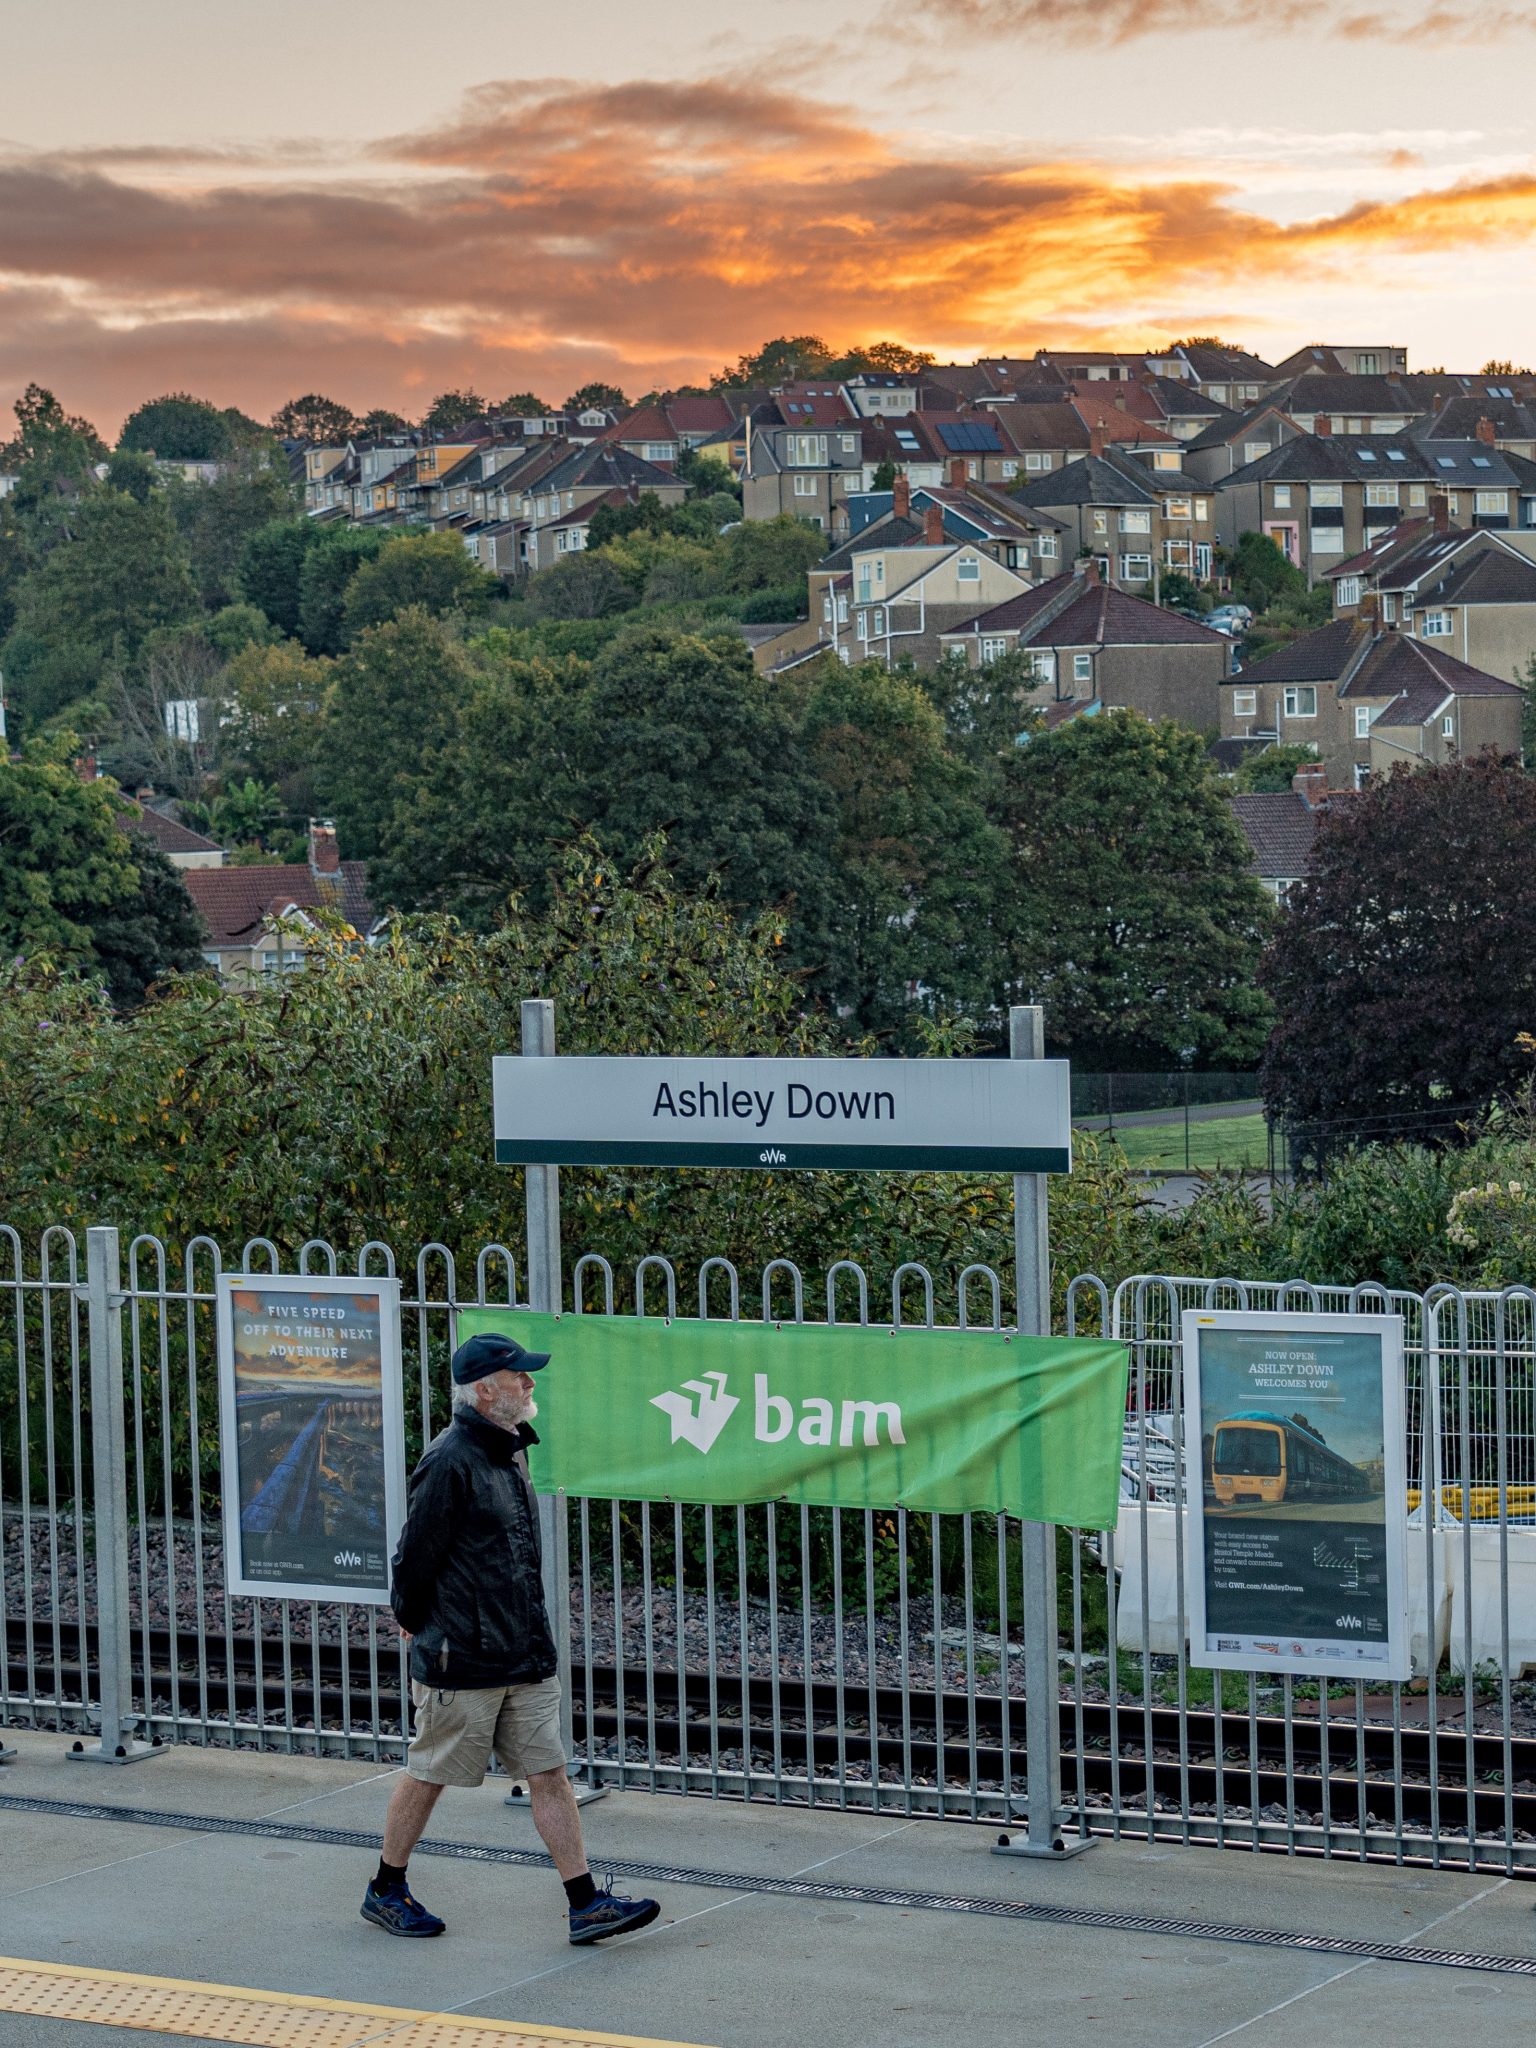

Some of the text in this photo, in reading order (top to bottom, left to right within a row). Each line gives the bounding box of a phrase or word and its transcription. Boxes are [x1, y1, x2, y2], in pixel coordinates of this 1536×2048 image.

[652, 1082, 896, 1128] Ashley Down
[759, 1147, 787, 1165] GWR
[268, 1306, 346, 1319] FIVE SPEED
[243, 1324, 373, 1340] OFF TO THEIR NEXT
[269, 1344, 348, 1359] ADVENTURE
[1265, 1351, 1317, 1360] NOW OPEN:
[1248, 1363, 1334, 1376] ASHLEY DOWN
[1254, 1378, 1328, 1389] WELCOMES YOU
[754, 1372, 907, 1447] bam
[1228, 1532, 1245, 1540] brand
[334, 1549, 362, 1567] GWR
[1214, 1548, 1274, 1558] Bristol Temple Meads
[1226, 1558, 1248, 1566] onward
[1228, 1581, 1304, 1592] GWR.com/AshleyDown
[1335, 1614, 1362, 1630] GWR
